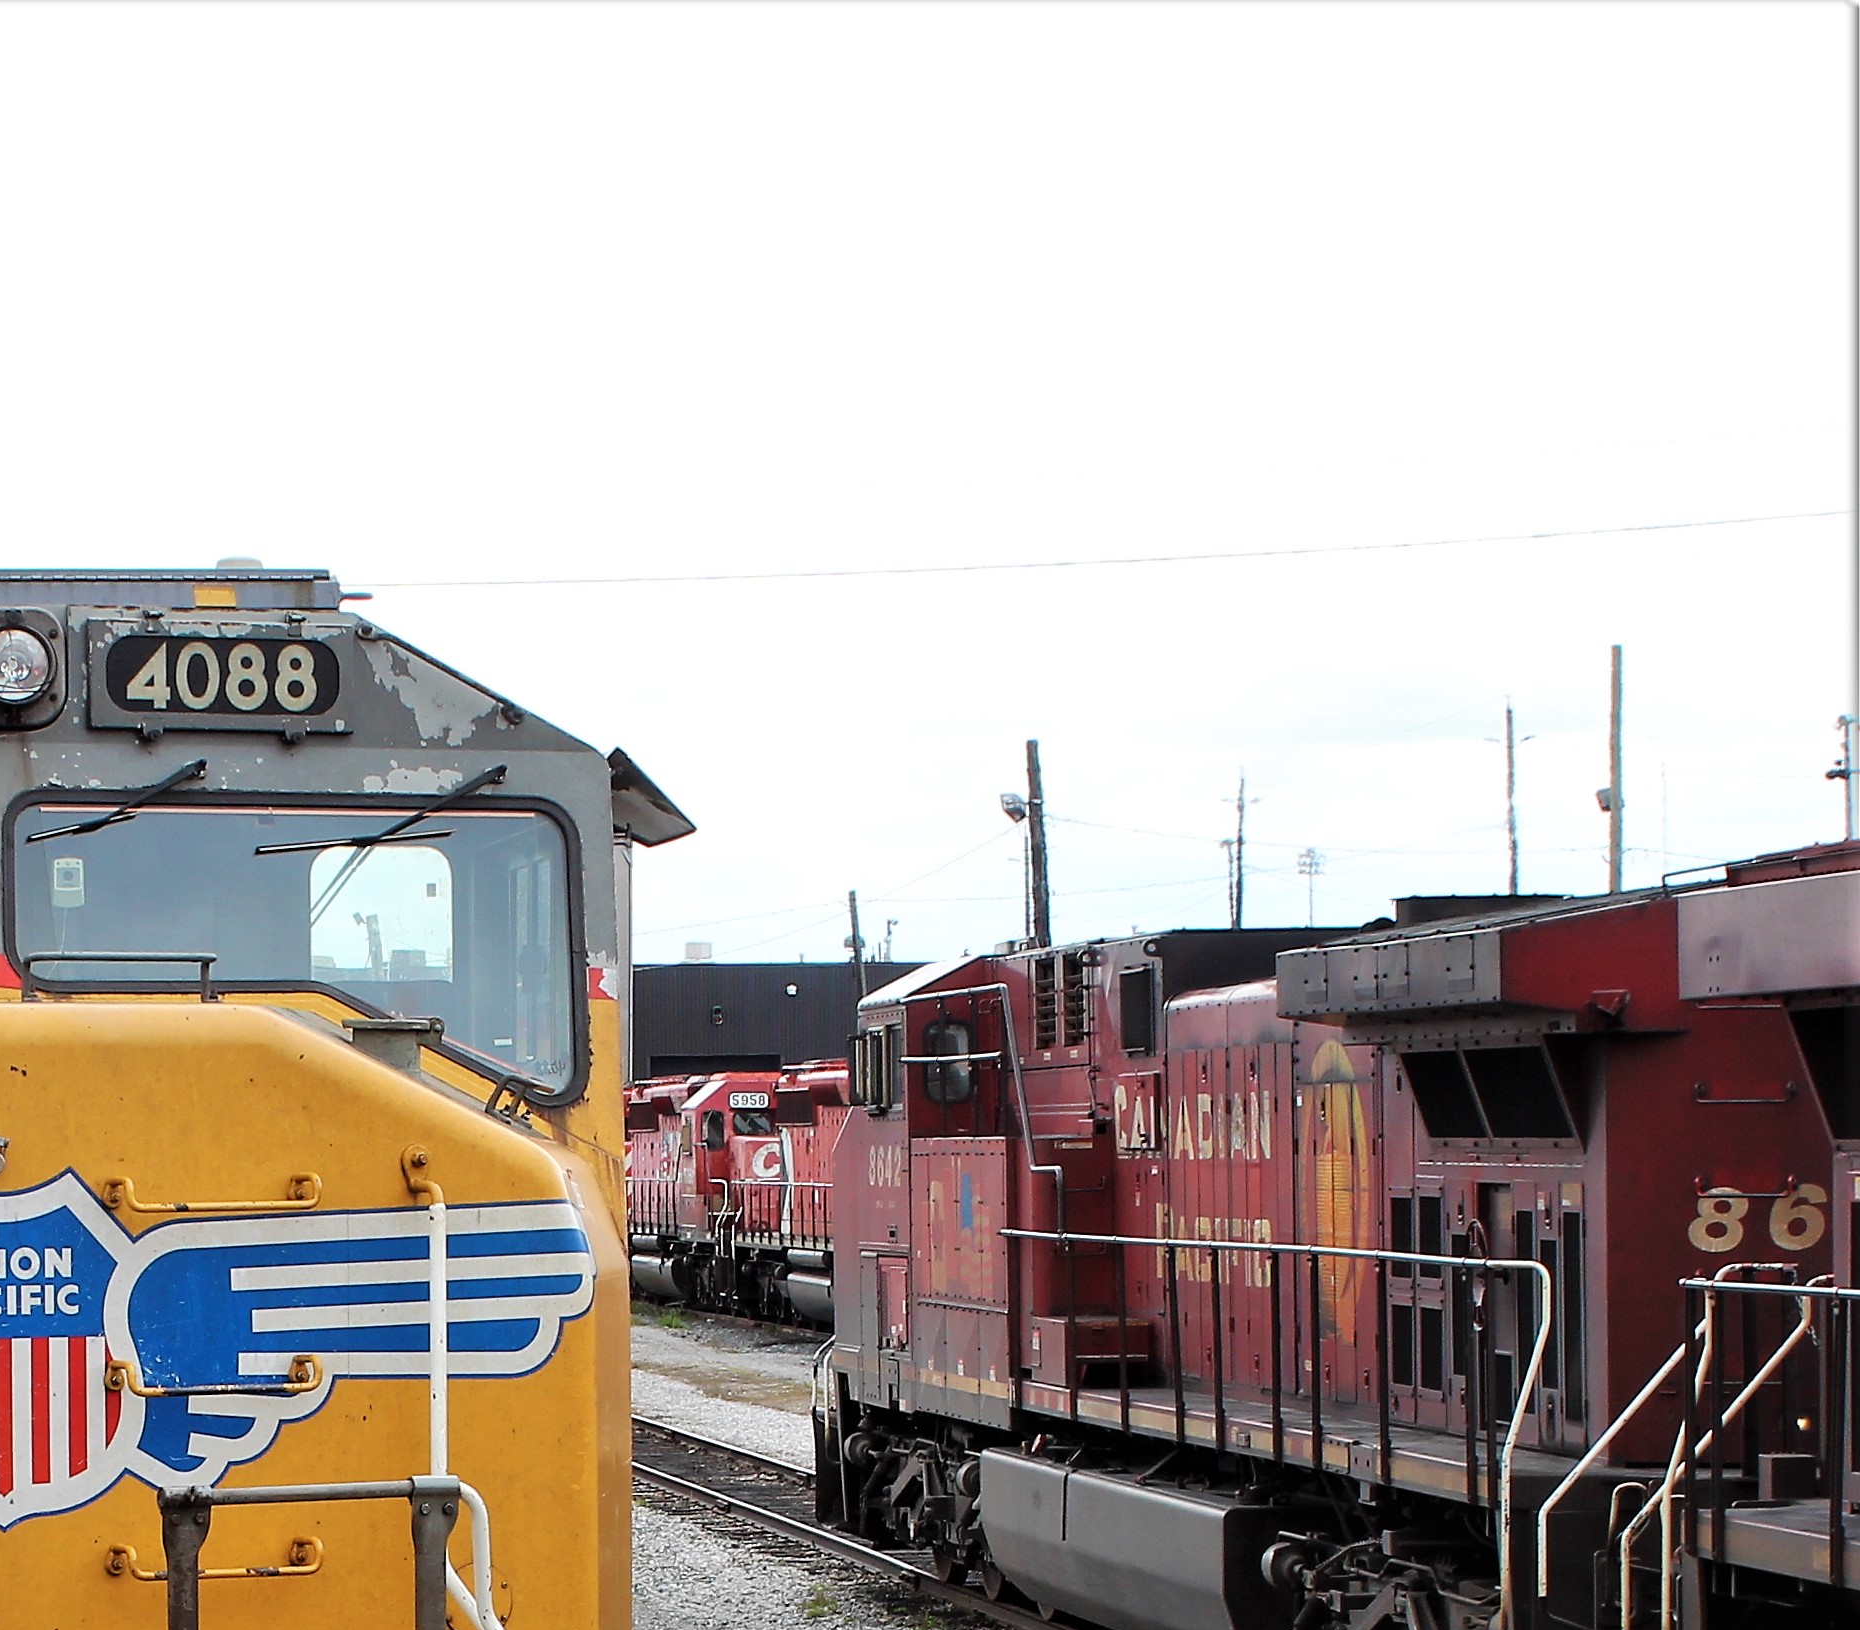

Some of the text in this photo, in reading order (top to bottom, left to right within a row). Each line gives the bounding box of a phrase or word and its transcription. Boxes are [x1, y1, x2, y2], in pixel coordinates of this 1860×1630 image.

[126, 640, 318, 712] 4088
[732, 1094, 766, 1107] 5958
[868, 1145, 902, 1188] 8642
[1156, 1202, 1272, 1288] PACIFIC
[1687, 1183, 1828, 1253] 86
